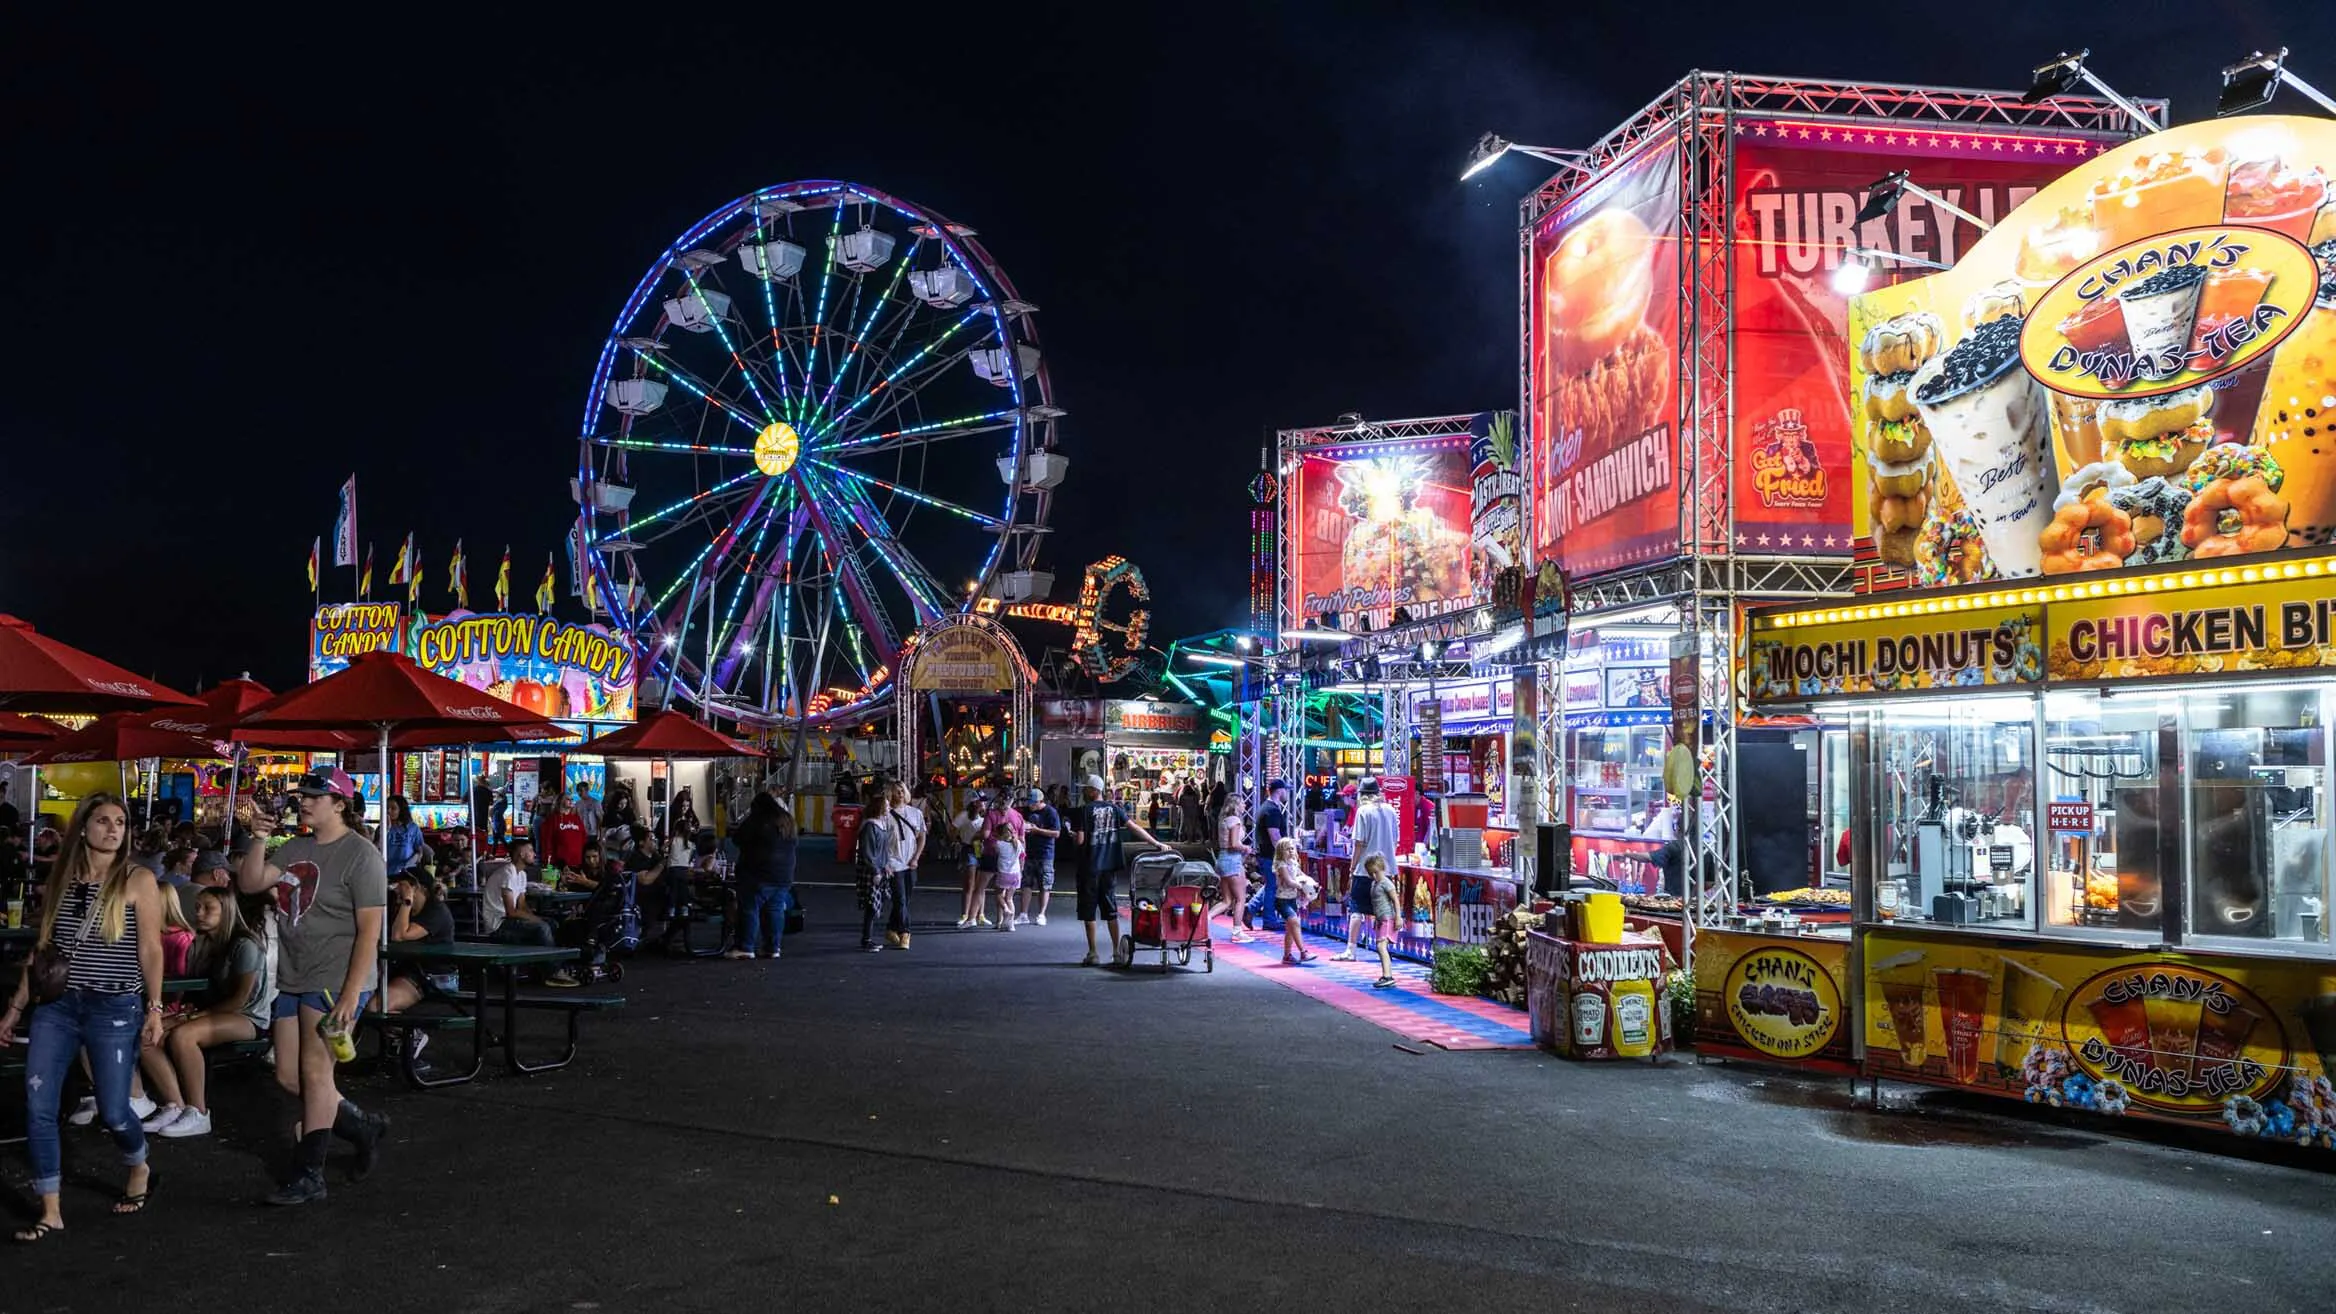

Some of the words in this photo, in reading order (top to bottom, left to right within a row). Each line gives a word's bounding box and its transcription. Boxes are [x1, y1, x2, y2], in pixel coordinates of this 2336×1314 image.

[2076, 232, 2250, 300] CHAN'S
[2047, 303, 2288, 382] DYNAS-TEA
[1574, 426, 1670, 525] SANDWICH
[1756, 467, 1825, 502] Fried
[1980, 452, 2026, 494] Best
[316, 603, 399, 631] COTTON
[1303, 590, 1349, 614] Fruity
[321, 631, 392, 657] CANDY
[419, 615, 535, 670] COTTON
[538, 622, 630, 681] CANDY
[2069, 605, 2267, 663] CHICKEN
[2281, 600, 2336, 648] BI
[1770, 639, 1869, 682] MOCHI
[1875, 626, 2017, 674] DONUTS
[2051, 805, 2075, 816] PICK
[2076, 805, 2090, 816] UP
[1578, 949, 1661, 983] CONDIMENTS
[1745, 957, 1816, 988] CHAN'S
[2103, 973, 2240, 1014] CHAN'S
[1731, 1004, 1775, 1046] CHICKEN
[1777, 1040, 1792, 1051] ON
[2079, 1036, 2268, 1097] DYNAS-TEA
